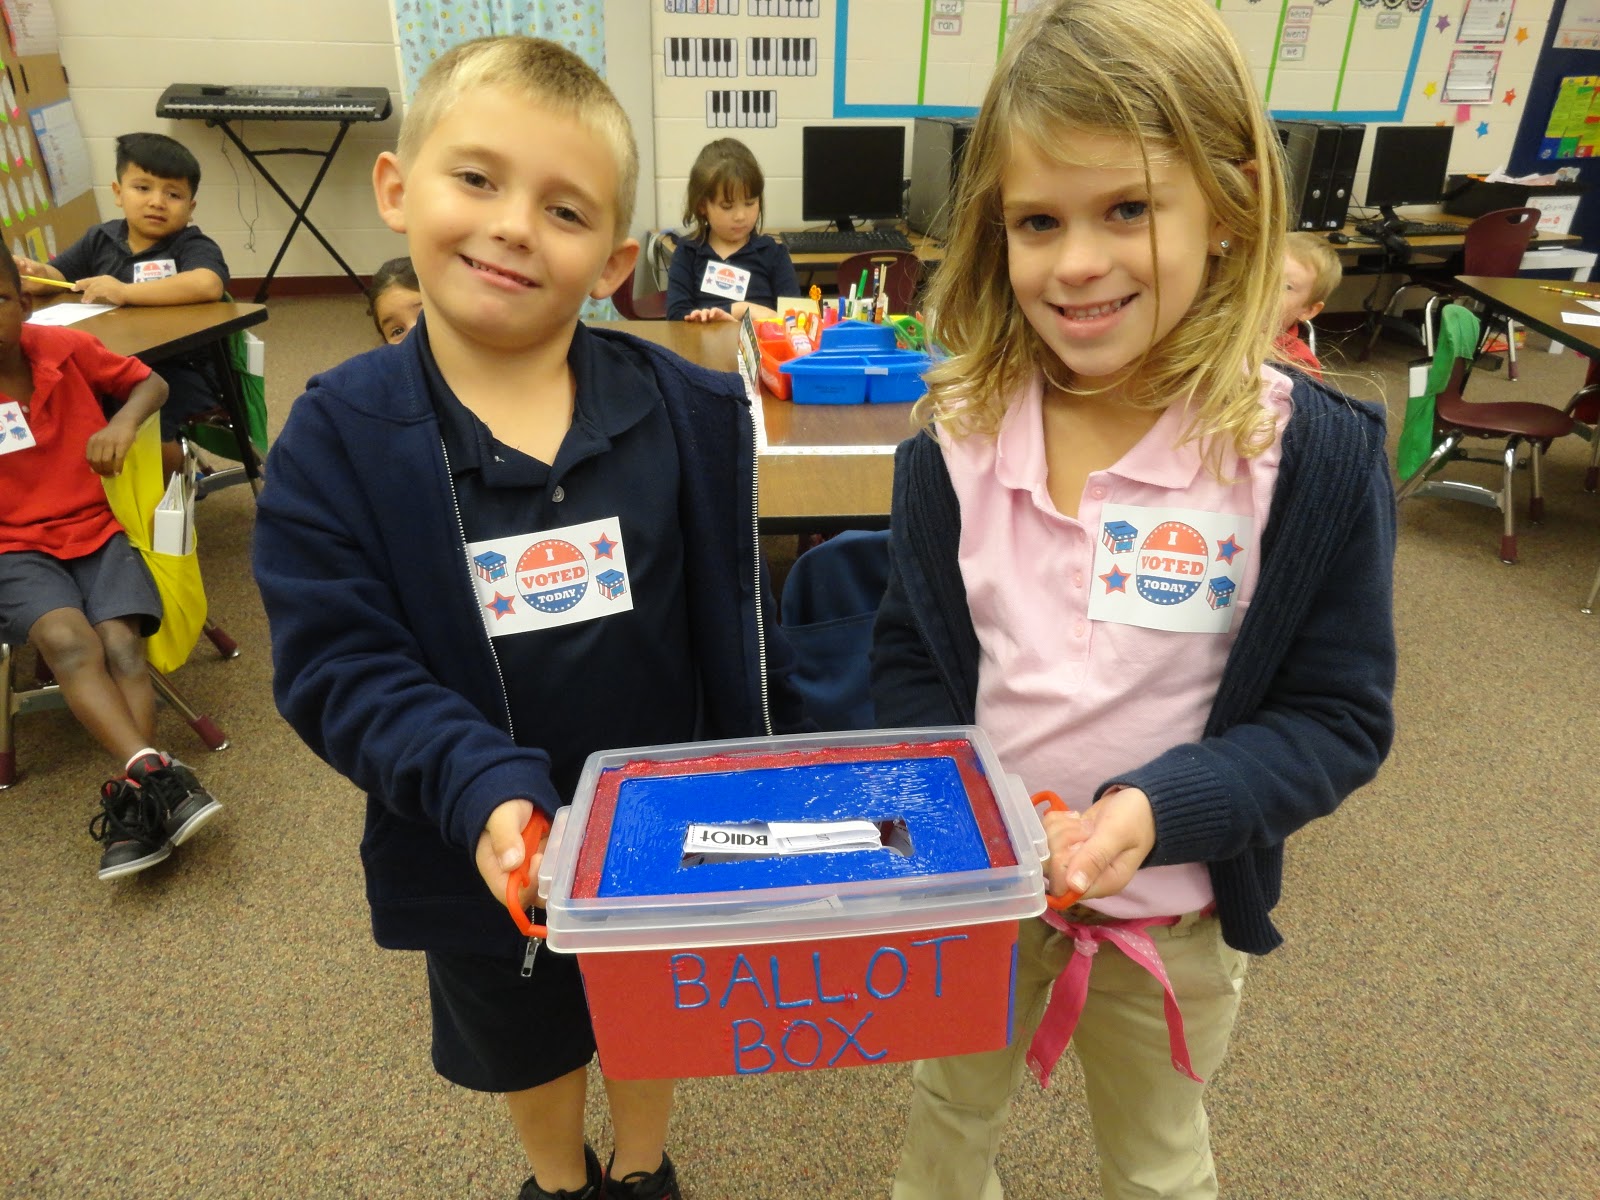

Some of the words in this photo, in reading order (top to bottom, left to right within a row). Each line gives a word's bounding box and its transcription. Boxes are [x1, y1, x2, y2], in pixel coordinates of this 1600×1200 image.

[941, 0, 958, 12] red
[938, 21, 954, 30] ran
[1167, 531, 1178, 546] I
[545, 548, 555, 561] I
[1141, 555, 1205, 576] VOTED
[521, 566, 586, 589] VOTED
[1143, 579, 1187, 594] TODAY
[537, 588, 577, 604] TODAY
[671, 934, 968, 1009] BALLOT
[732, 1011, 888, 1074] BOX
